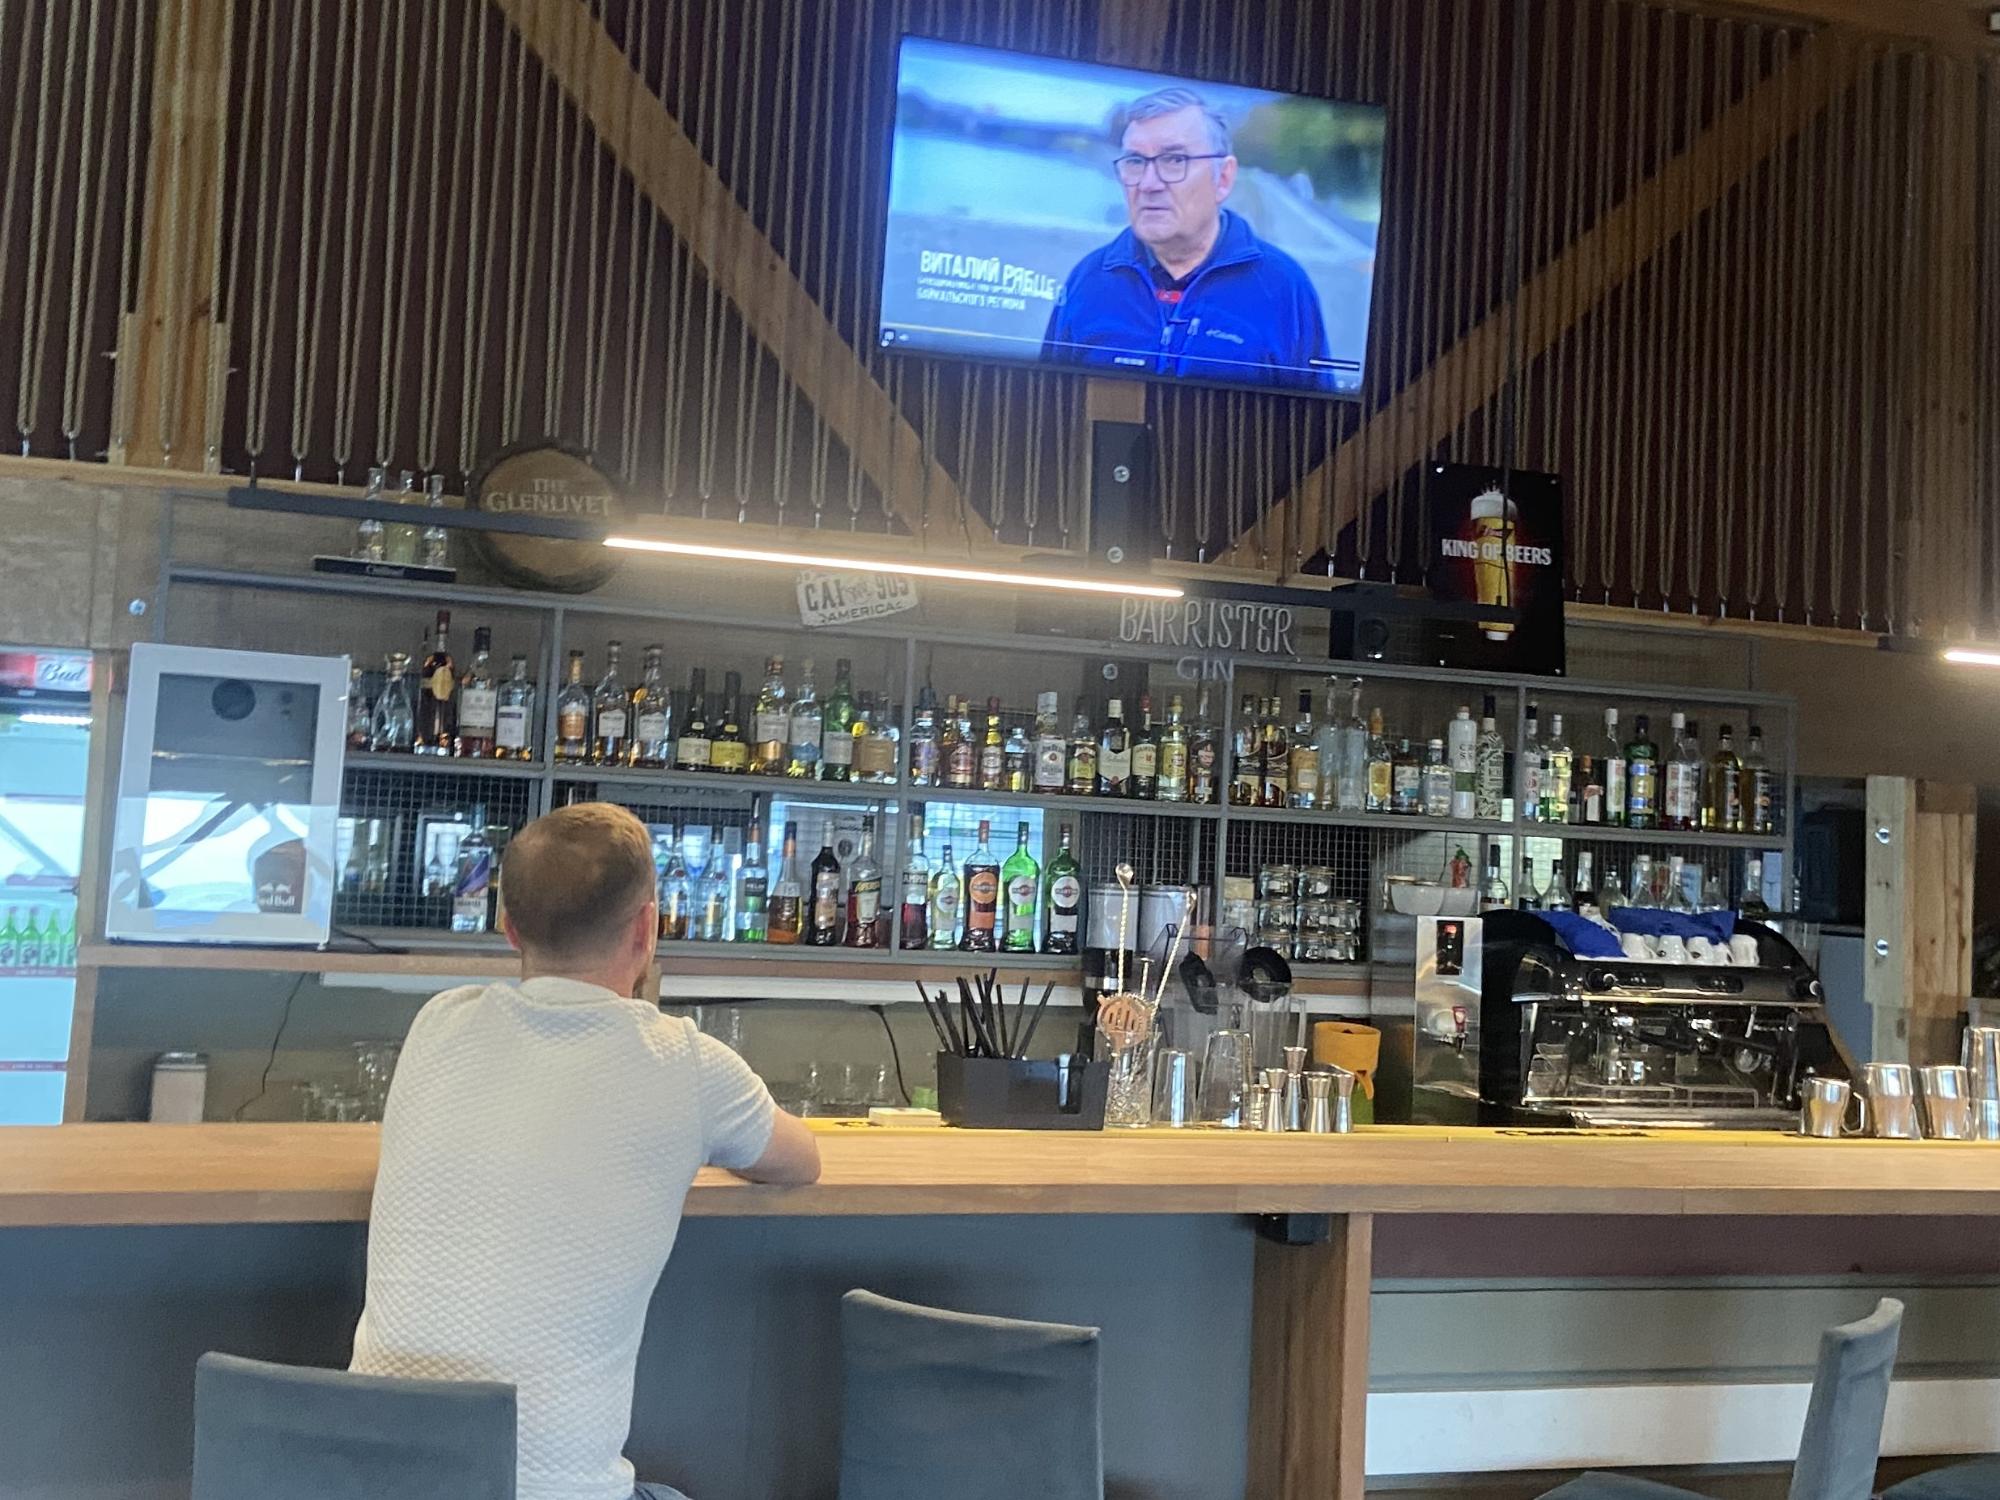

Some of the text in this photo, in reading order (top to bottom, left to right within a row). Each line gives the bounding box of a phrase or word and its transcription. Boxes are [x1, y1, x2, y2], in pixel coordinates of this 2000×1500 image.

[920, 250, 999, 283] ВИТАЛИЙ
[486, 491, 612, 516] GLENLIVET
[1441, 538, 1553, 566] KING OF BEERS
[1119, 596, 1295, 655] BARRISTER
[41, 663, 86, 681] Bud
[1176, 656, 1234, 683] GIN
